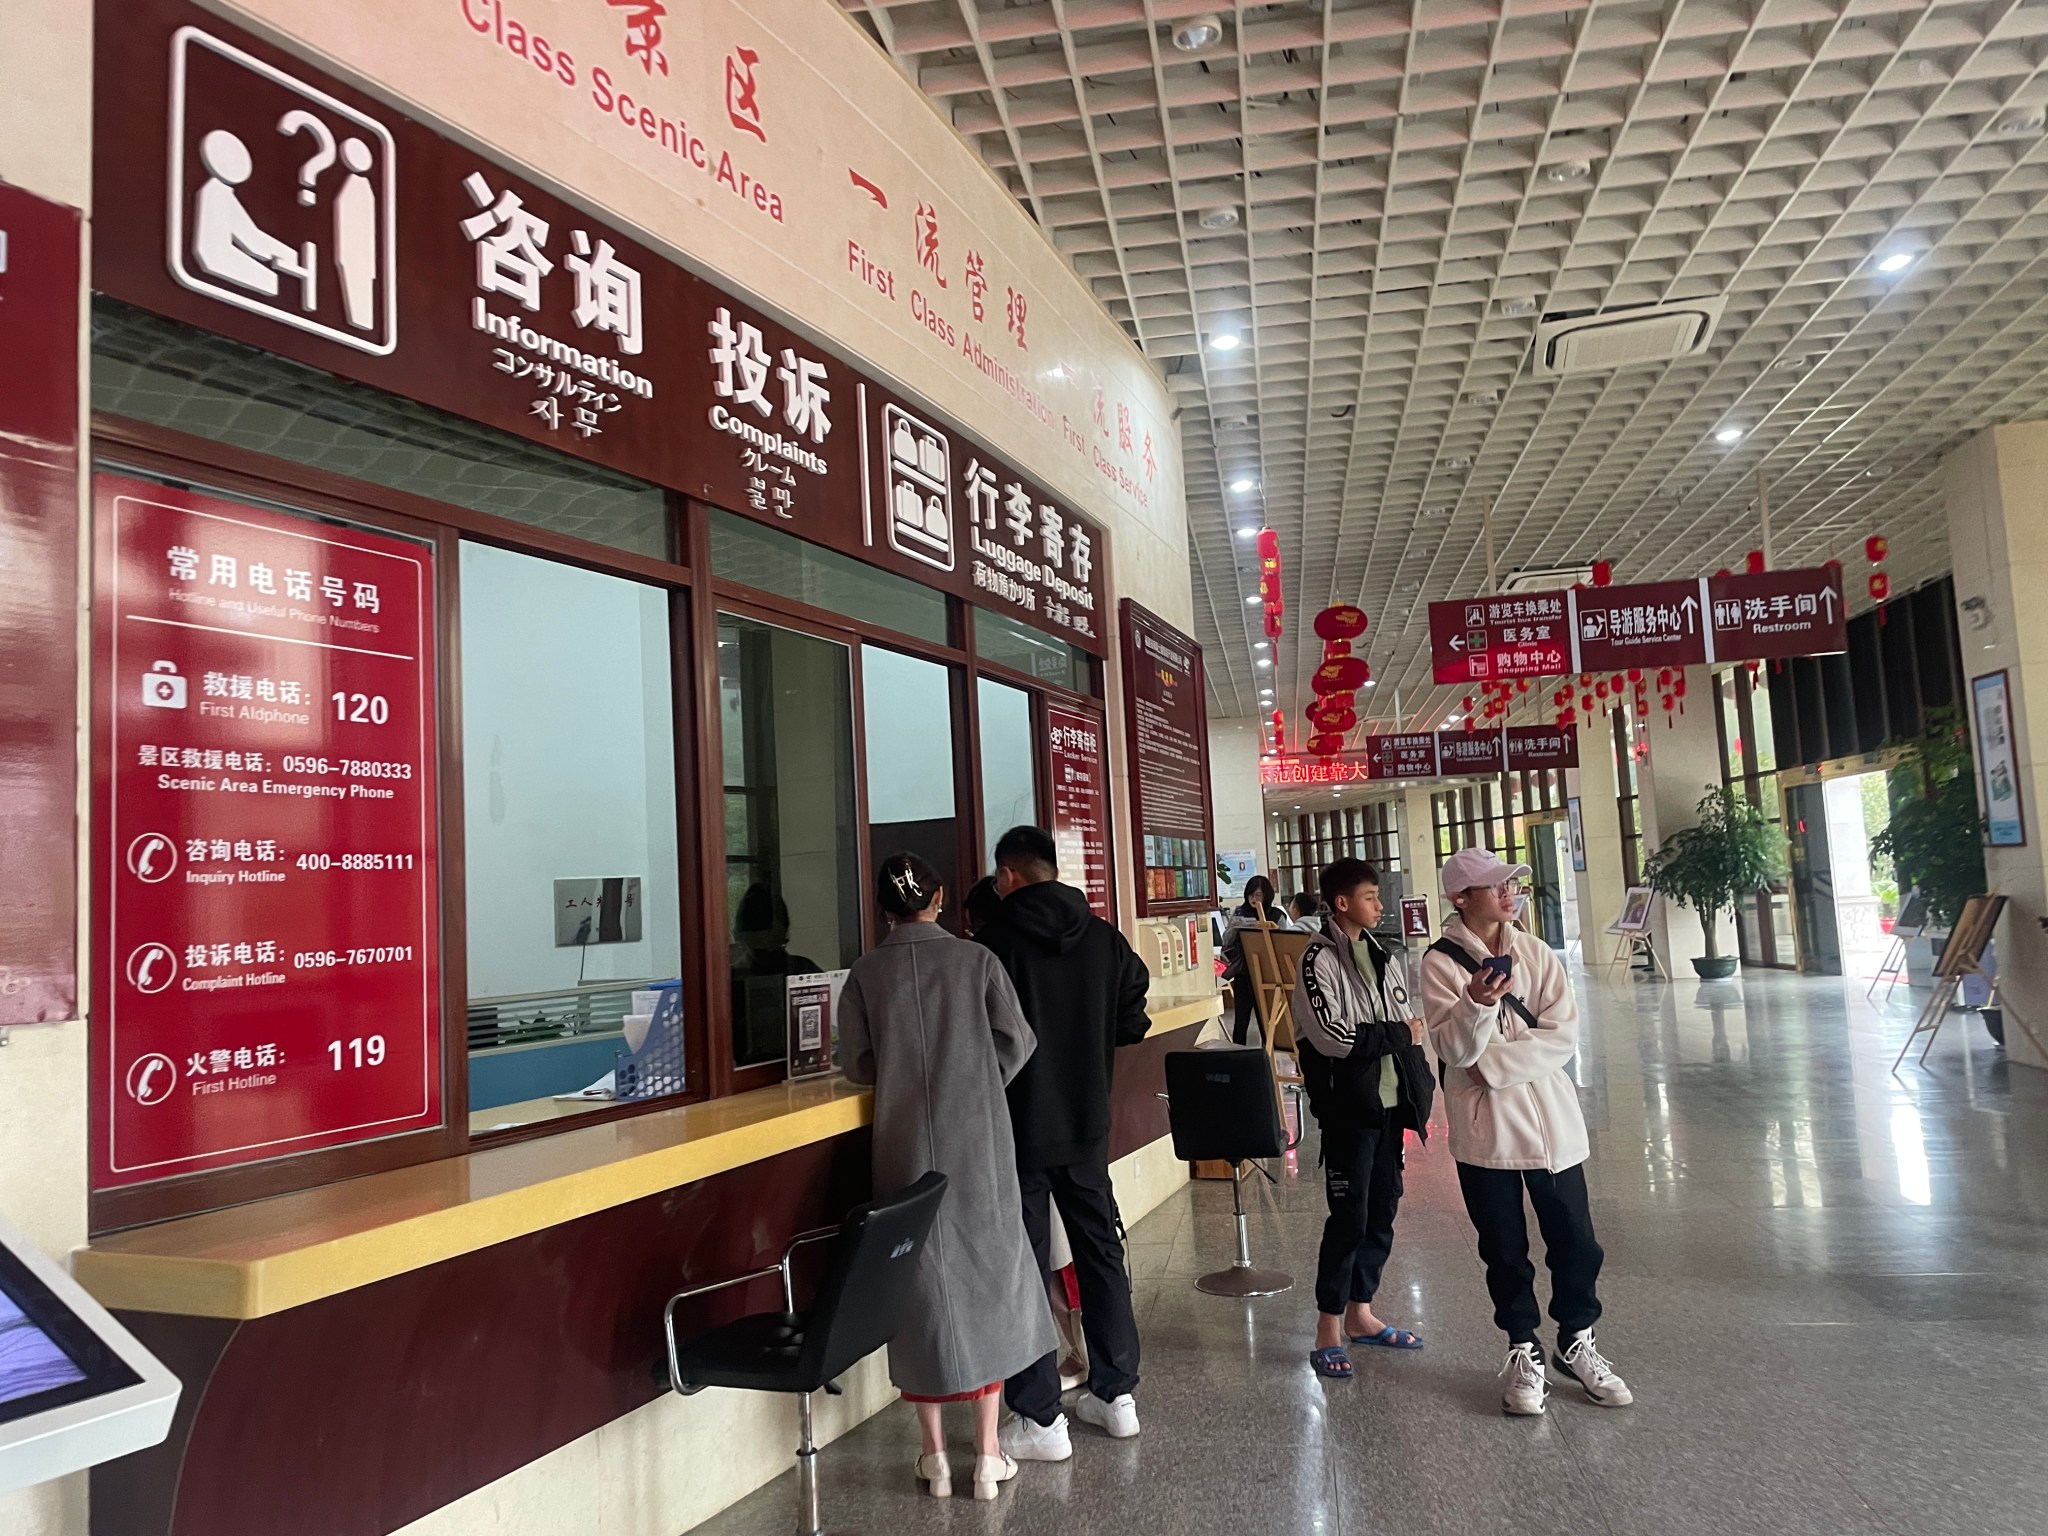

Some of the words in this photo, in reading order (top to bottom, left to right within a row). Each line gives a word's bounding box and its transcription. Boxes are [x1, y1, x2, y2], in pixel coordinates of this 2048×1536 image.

[461, 0, 577, 87] Class
[592, 66, 706, 169] Scenic
[716, 150, 784, 224] Area
[459, 171, 643, 355] 咨询
[848, 167, 1029, 351] 一流管理
[472, 296, 654, 399] Information
[848, 238, 896, 302] First
[911, 289, 956, 347] Class
[963, 332, 1055, 431] Administration
[492, 347, 622, 412] コンサルティン
[708, 307, 832, 444] 投诉
[708, 405, 828, 475] Complaints
[740, 447, 797, 486] クレーム
[1063, 416, 1085, 455] First
[1093, 445, 1117, 482] Class
[1119, 466, 1148, 507] Service
[963, 457, 1092, 583] 行李寄存
[166, 545, 381, 614] 常用电话号码
[970, 525, 1041, 582] Luggage
[1042, 564, 1094, 611] Deposit
[168, 588, 216, 607] Hotline
[219, 599, 244, 611] and
[247, 603, 287, 618] Useful
[289, 608, 326, 625] Phone
[329, 615, 381, 633] Numbers
[1489, 598, 1562, 619] 游览车换乘处
[1490, 618, 1516, 626] Tourist
[1533, 614, 1562, 622] transfer
[1610, 604, 1682, 636] 导游服务中心
[1745, 593, 1817, 620] 洗手间
[1503, 625, 1551, 643] 医务室
[1611, 637, 1624, 647] Tour
[1625, 636, 1641, 646] Guide
[1642, 634, 1663, 645] Service
[1663, 633, 1682, 643] Center
[1753, 621, 1811, 634] Restroom
[1497, 649, 1562, 668] 购物中心
[1497, 665, 1539, 675] Shopping
[1542, 662, 1561, 670] Mall
[200, 702, 235, 719] First
[203, 671, 311, 706] 救援电话：
[331, 691, 389, 725] 120
[1063, 725, 1097, 753] 行李寄存柜
[1525, 737, 1560, 751] 洗手间
[138, 745, 271, 773] 景区救援电话：
[282, 755, 412, 780] 0596-7880333
[158, 774, 216, 791] Scenic
[219, 778, 258, 793] Area
[262, 780, 347, 799] Emergency
[350, 784, 394, 799] Phone
[186, 838, 286, 863] 咨询电话：
[296, 854, 413, 871] 400-8885111
[186, 870, 235, 885] Inquiry
[238, 870, 286, 883] Hotline
[185, 940, 285, 969] 投诉电话：
[294, 946, 412, 970] 0596-7670701
[182, 976, 243, 993] Complaint
[245, 972, 286, 986] Hotline
[185, 1043, 286, 1077] 火警电话：
[327, 1034, 386, 1072] 119
[192, 1080, 224, 1096] First
[228, 1073, 277, 1091] Hotline
